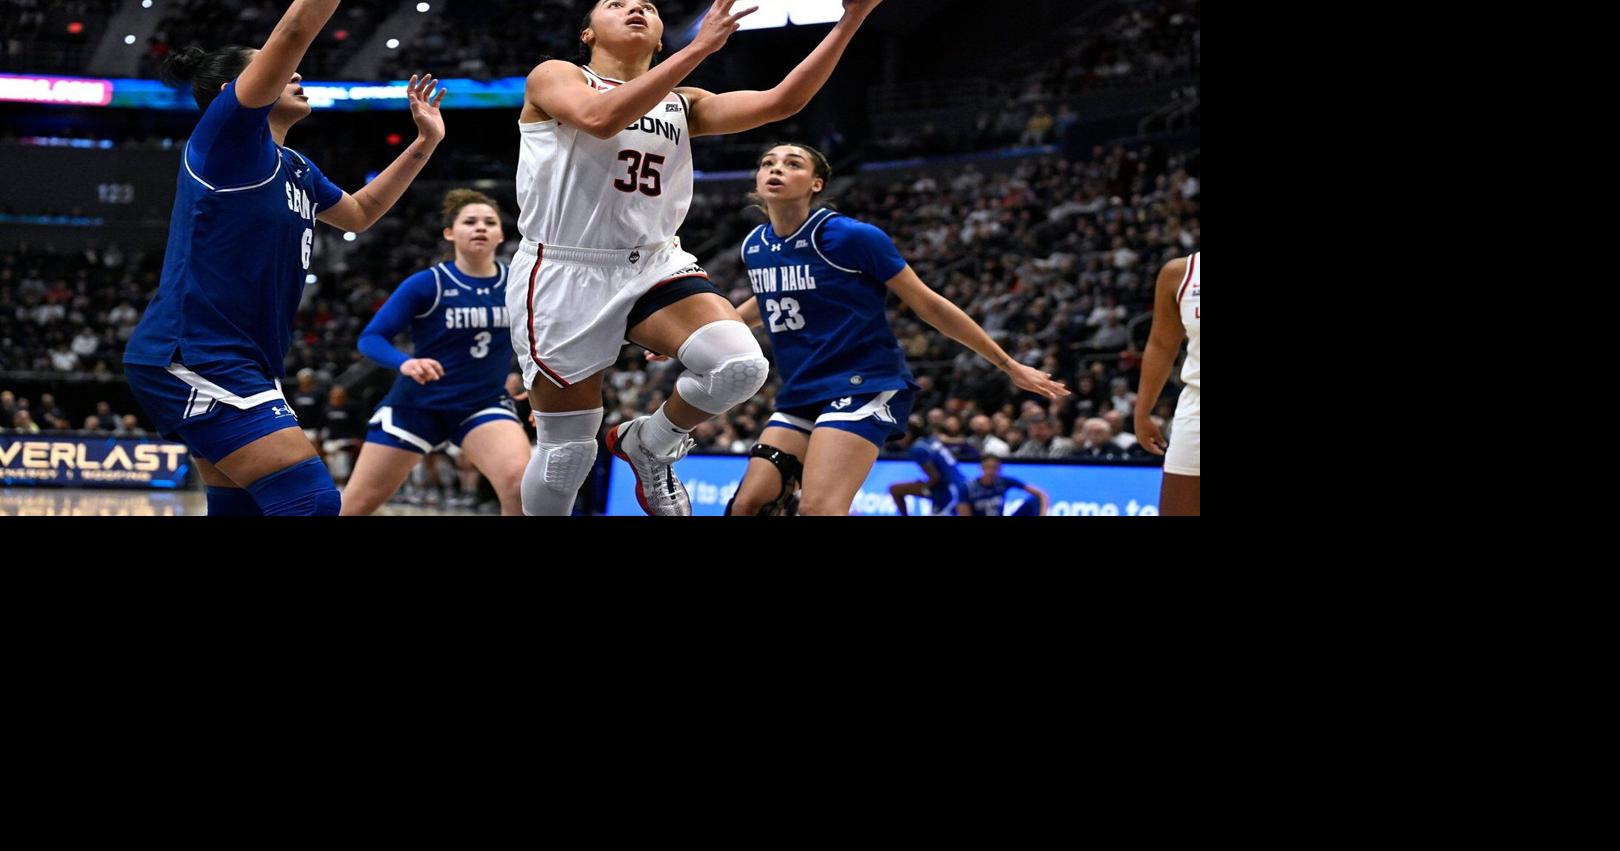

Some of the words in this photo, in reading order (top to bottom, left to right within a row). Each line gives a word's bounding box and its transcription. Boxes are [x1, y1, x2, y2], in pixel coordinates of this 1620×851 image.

[624, 116, 681, 146] ONN
[613, 149, 665, 197] 35
[301, 227, 313, 270] 6
[779, 264, 816, 292] HALL
[445, 306, 489, 330] SETON
[491, 305, 511, 328] HA
[765, 297, 806, 333] 23
[469, 331, 492, 359] 3
